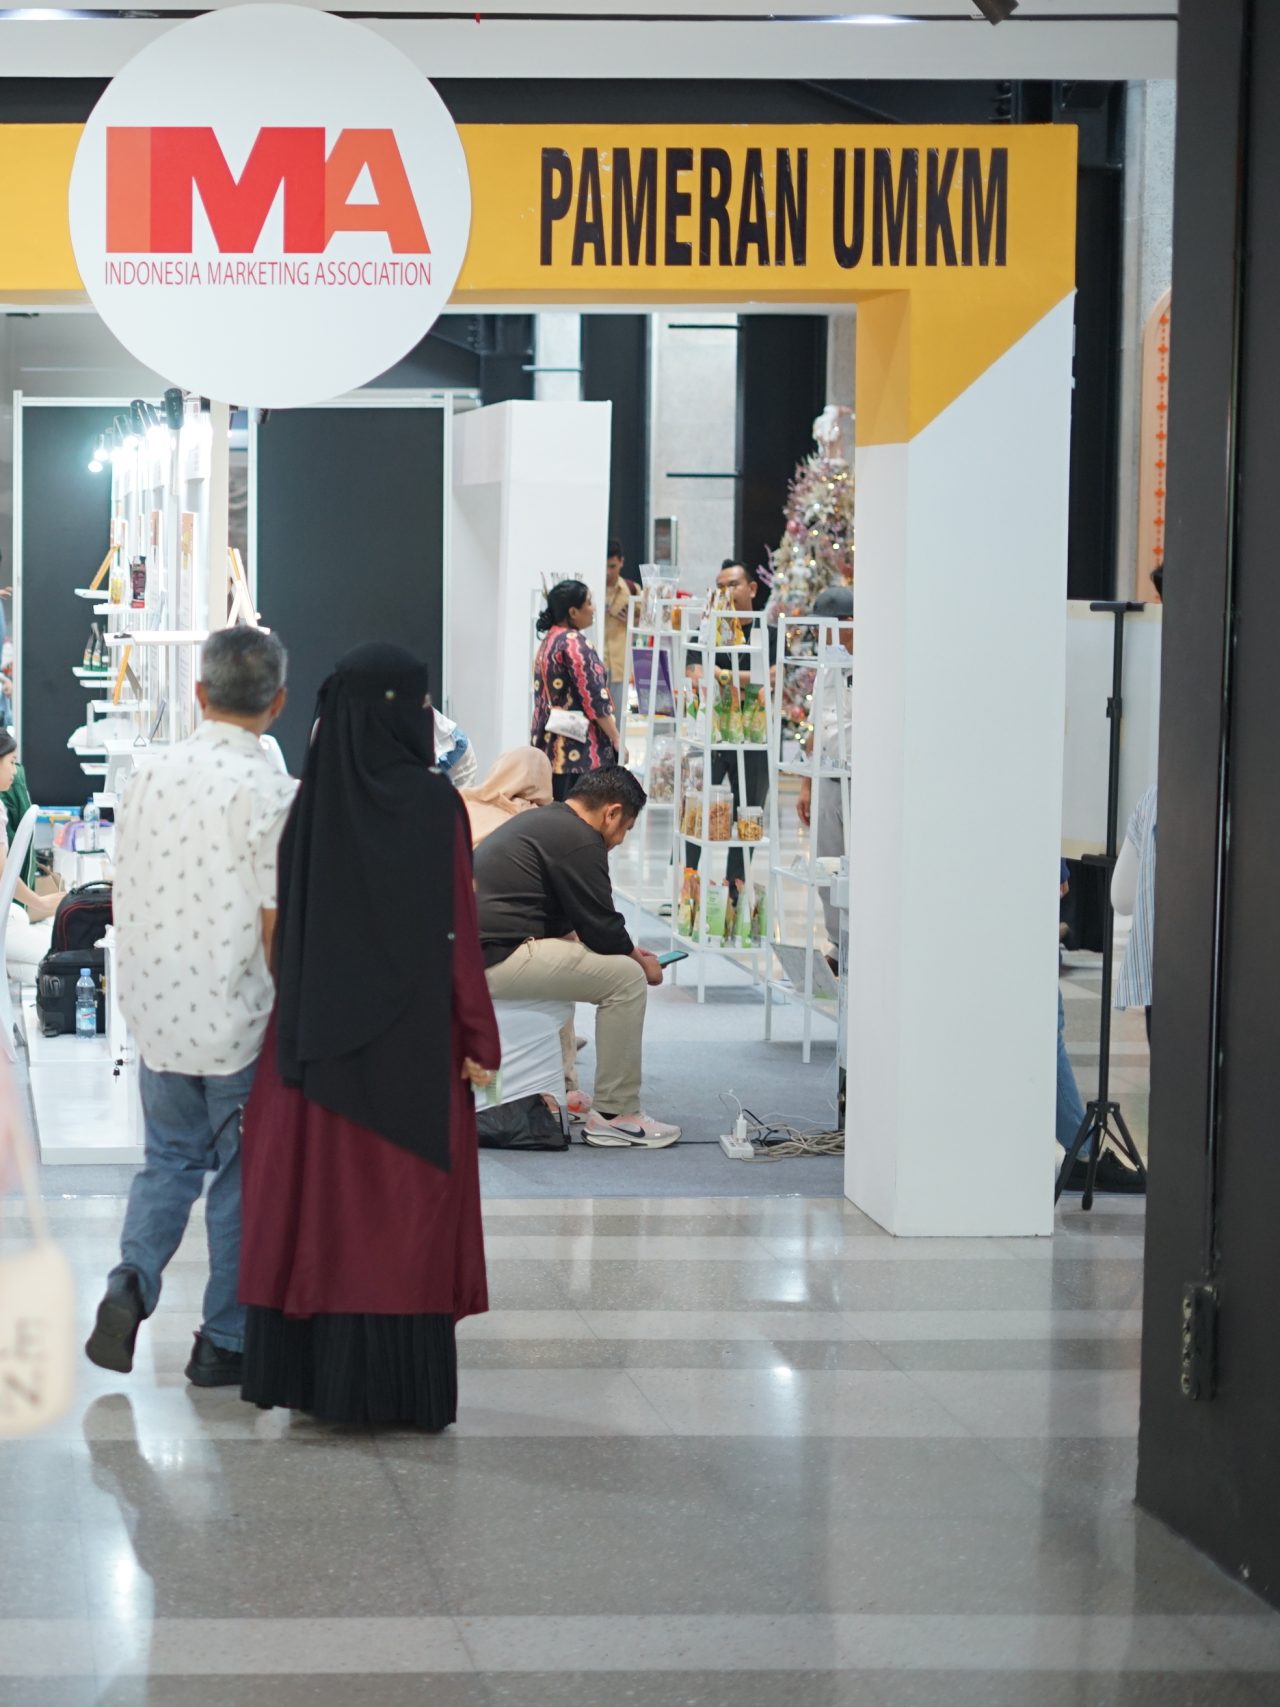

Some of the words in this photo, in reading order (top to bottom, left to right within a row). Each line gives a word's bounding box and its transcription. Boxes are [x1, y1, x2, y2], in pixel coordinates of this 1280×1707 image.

[106, 126, 431, 254] IMA
[540, 147, 808, 266] PAMERAN
[832, 147, 1008, 268] UMKM
[105, 261, 201, 286] INDONESIA
[207, 261, 308, 286] MARKETING
[315, 261, 431, 286] ASSOCIATION
